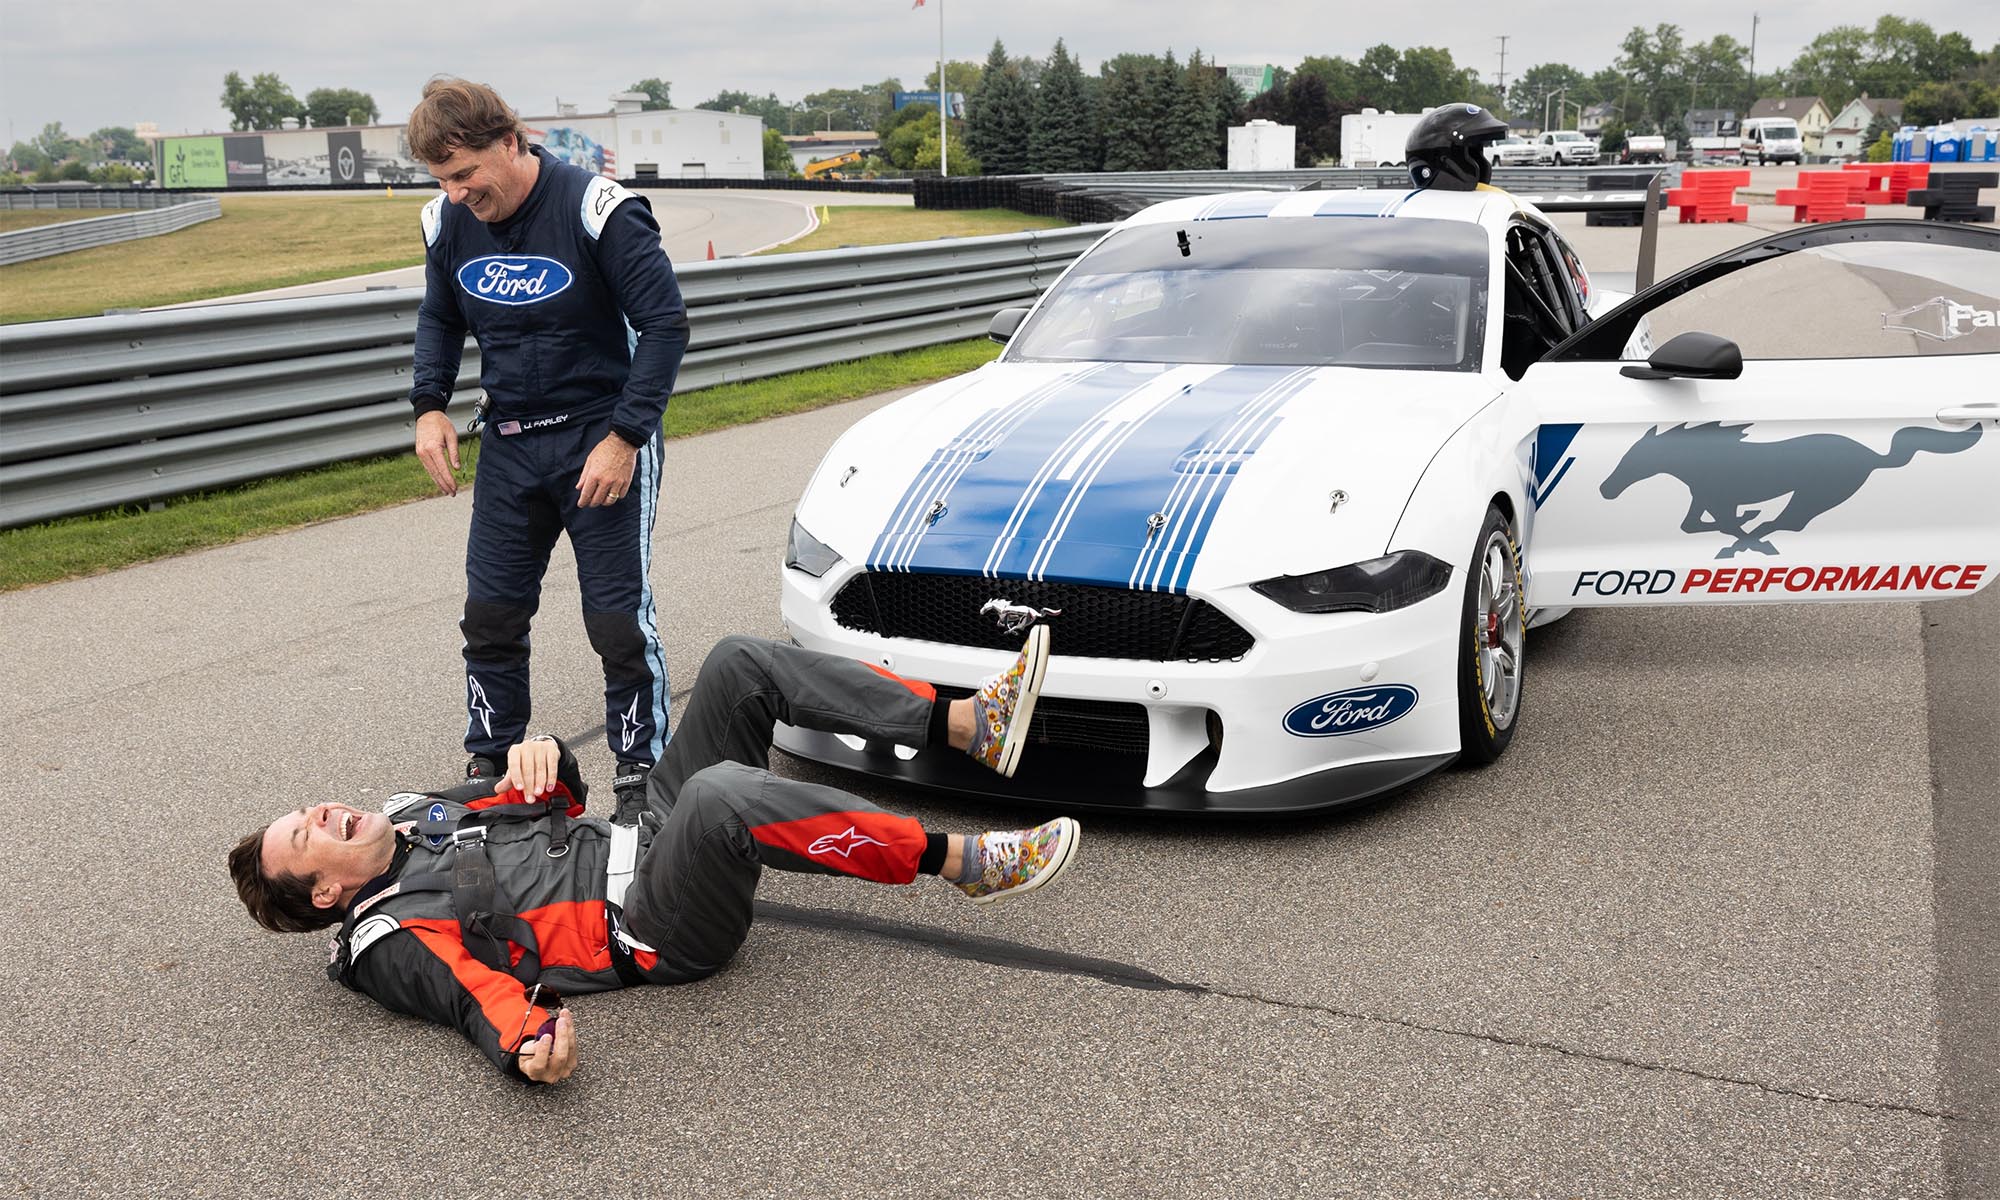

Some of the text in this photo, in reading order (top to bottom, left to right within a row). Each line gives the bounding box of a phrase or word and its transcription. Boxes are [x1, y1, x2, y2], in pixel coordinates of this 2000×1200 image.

[477, 261, 548, 297] Ford
[533, 413, 569, 428] FARLEY
[1571, 564, 1987, 596] FORD PERFORMANCE
[1310, 693, 1395, 730] Ford
